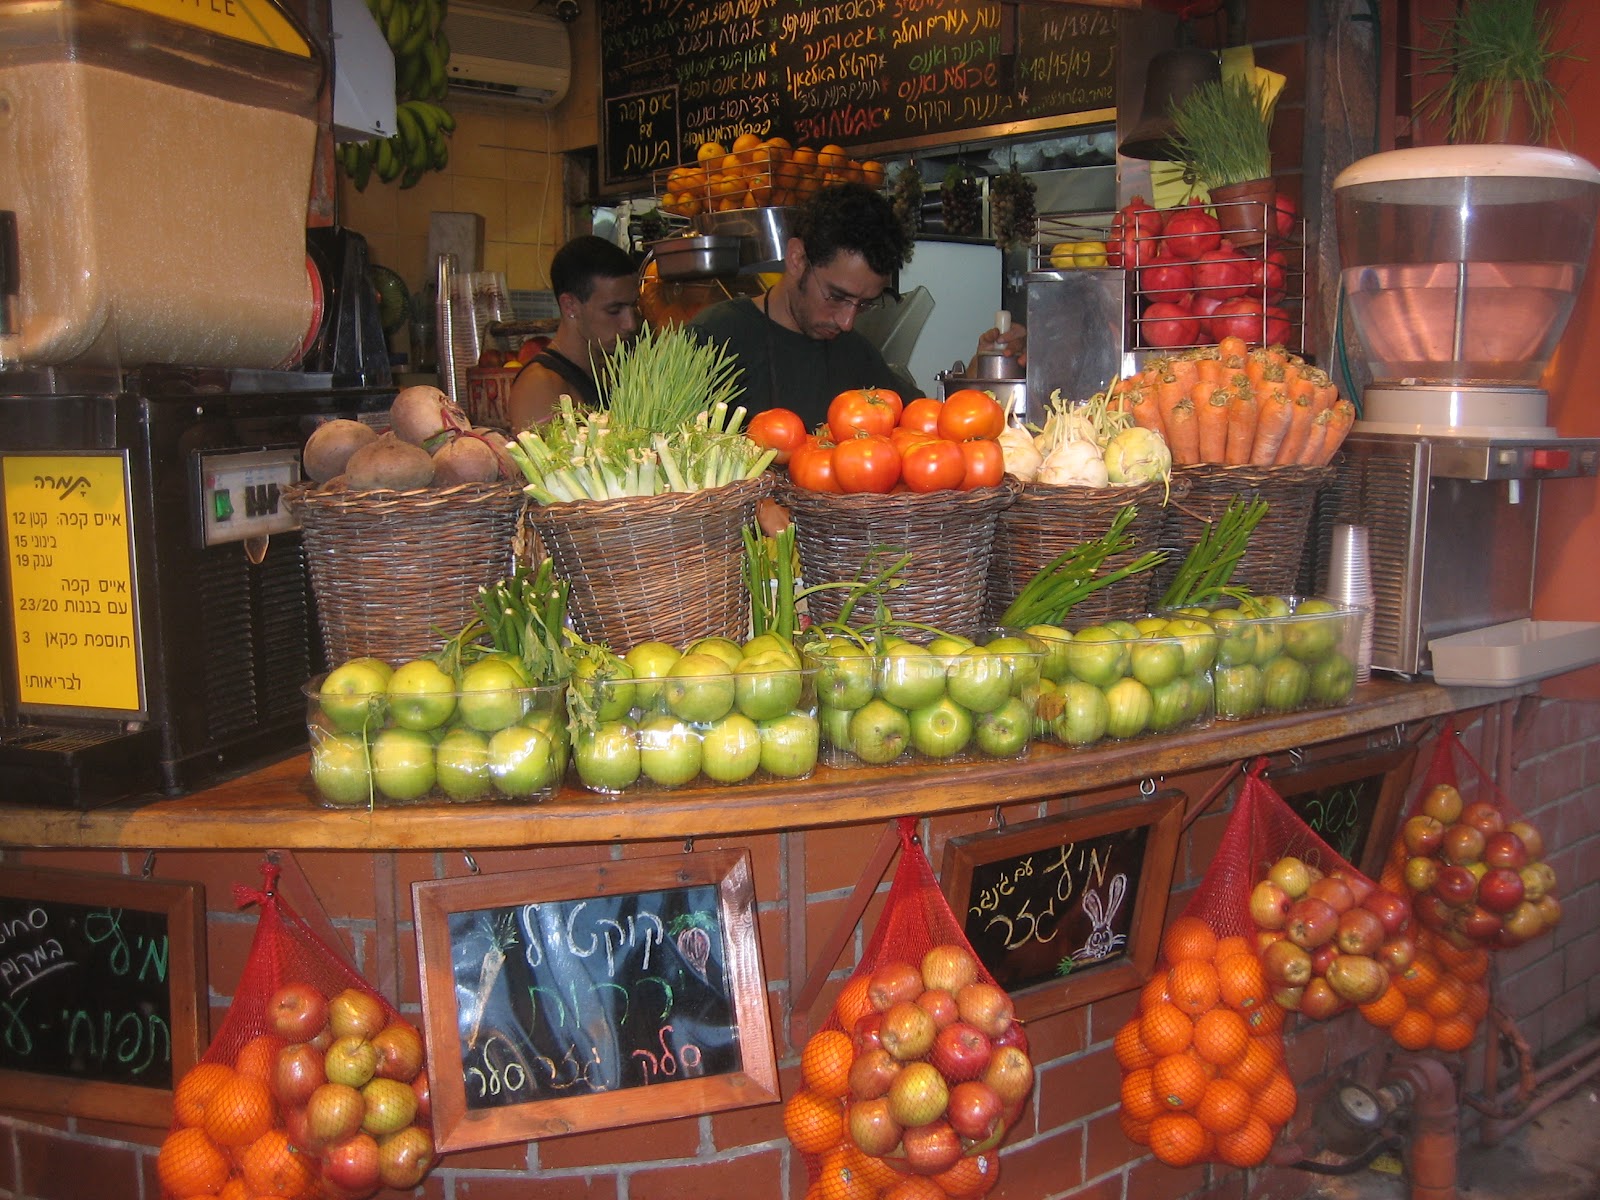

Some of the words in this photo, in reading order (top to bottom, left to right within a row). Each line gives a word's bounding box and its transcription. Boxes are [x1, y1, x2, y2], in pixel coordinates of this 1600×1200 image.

[927, 8, 968, 37] תמרים
[970, 5, 1001, 35] ננות
[718, 19, 764, 48] אבטיח
[844, 26, 876, 49] אגס
[893, 17, 922, 49] וחלב
[744, 43, 766, 73] מלון
[803, 33, 840, 62] ובננה
[952, 39, 984, 63] בננה
[909, 45, 947, 74] ואננס
[1030, 46, 1091, 84] 12/15/19
[849, 79, 881, 101] תותים
[898, 73, 936, 103] ואננס
[829, 104, 881, 139] אבטיח
[905, 100, 951, 130] וקוקוס
[639, 121, 653, 142] עם
[623, 139, 670, 171] בננות
[13, 511, 26, 525] 12
[30, 511, 48, 527] קטן
[56, 511, 88, 530] קפה:
[94, 512, 121, 527] אייס
[15, 535, 28, 548] 15
[31, 535, 57, 549] בינוני
[16, 554, 29, 567] 19
[33, 554, 53, 568] ענק
[61, 578, 90, 596] קפה
[99, 579, 126, 593] אייס
[19, 597, 58, 612] 23/20
[64, 599, 101, 614] בננות
[107, 600, 128, 615] עם
[22, 630, 31, 644] 3
[45, 631, 78, 650] פקאן
[83, 634, 131, 649] תוספת
[25, 672, 81, 691] לבריאות!
[1014, 856, 1033, 883] עם
[984, 896, 1058, 951] גזר
[630, 1025, 701, 1087] סלק
